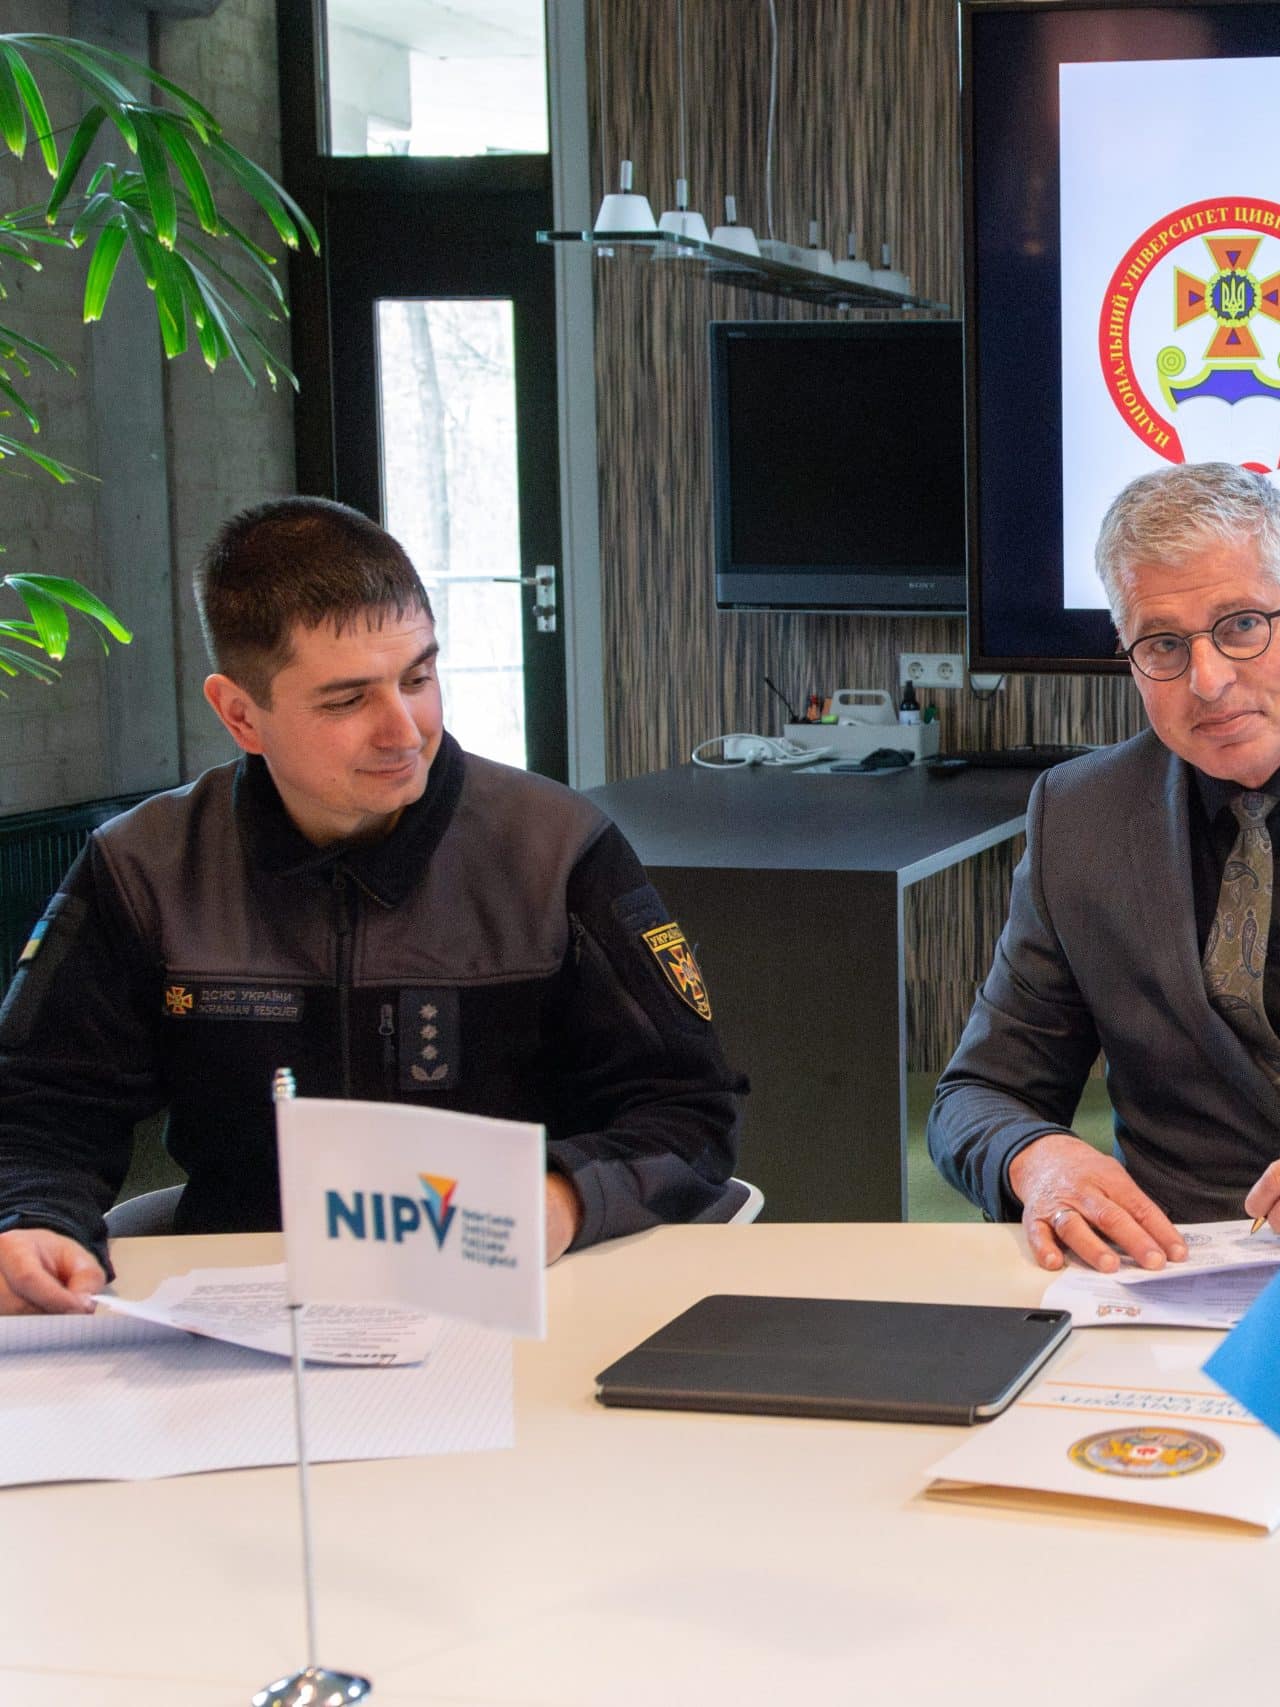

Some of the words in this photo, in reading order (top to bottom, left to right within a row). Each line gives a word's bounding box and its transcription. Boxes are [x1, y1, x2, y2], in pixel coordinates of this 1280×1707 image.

[1120, 207, 1229, 290] УНІВЕРСИТЕТ
[1109, 294, 1170, 449] НАЦІОНАЛЬНИЙ
[326, 1190, 457, 1251] NIPV
